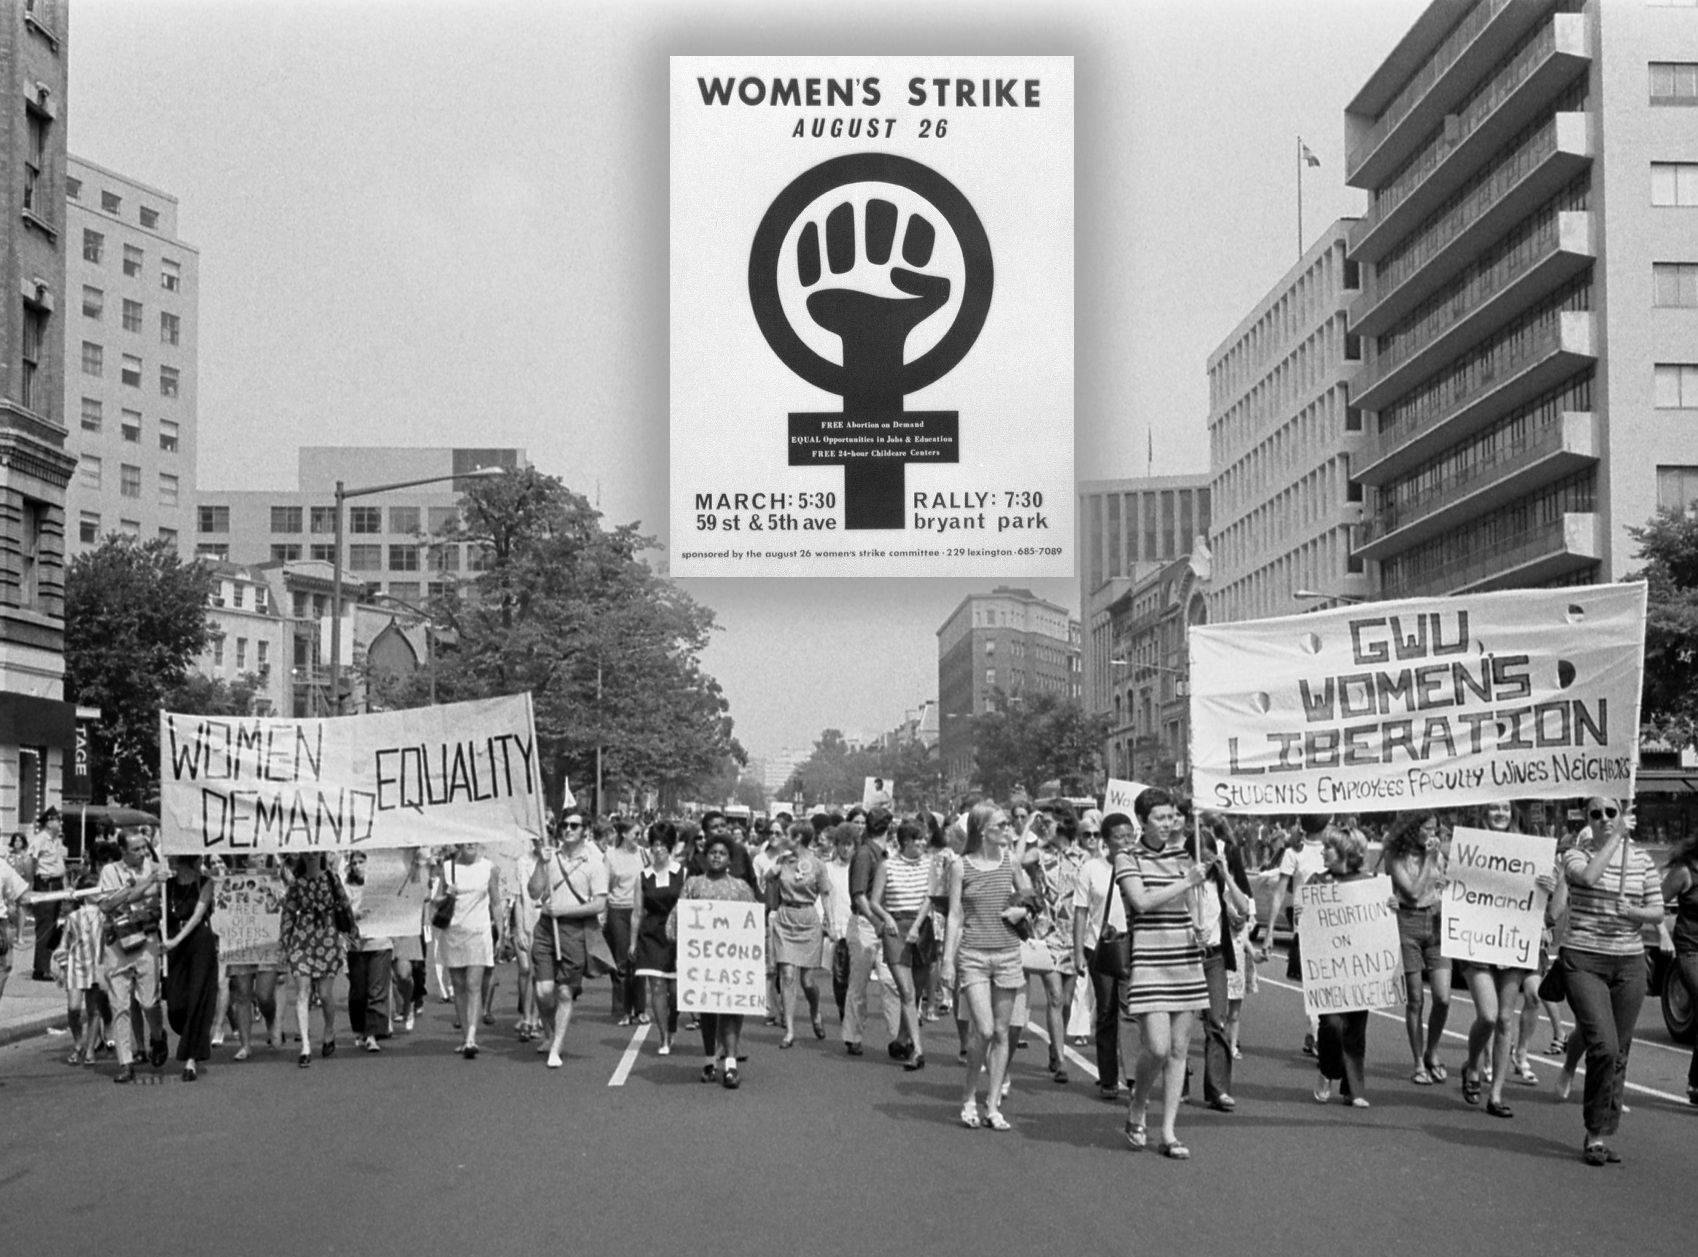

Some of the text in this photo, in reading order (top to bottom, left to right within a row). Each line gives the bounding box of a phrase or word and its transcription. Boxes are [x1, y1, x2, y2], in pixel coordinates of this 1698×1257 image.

[1349, 611, 1469, 665] GWU
[1300, 653, 1532, 722] WOMEN'S
[168, 715, 322, 782] WOMEN
[1228, 698, 1608, 775] LIBERATION
[376, 733, 534, 815] EQUALITY
[202, 787, 376, 848] DEMAND
[1457, 842, 1536, 876] Women
[1301, 884, 1342, 905] FREE
[1451, 880, 1535, 912] Demand
[228, 904, 259, 915] FREE
[232, 915, 256, 927] OUR
[743, 910, 757, 930] A
[1317, 901, 1388, 928] ABORTION
[219, 927, 270, 938] SISTERS
[227, 939, 260, 950] FREE
[1331, 934, 1352, 949] ON
[1447, 917, 1531, 963] Equality
[687, 938, 763, 961] SECOND
[686, 967, 756, 986] CLASS
[1306, 949, 1396, 980] DEMAND
[1307, 985, 1349, 1009] WOMEN
